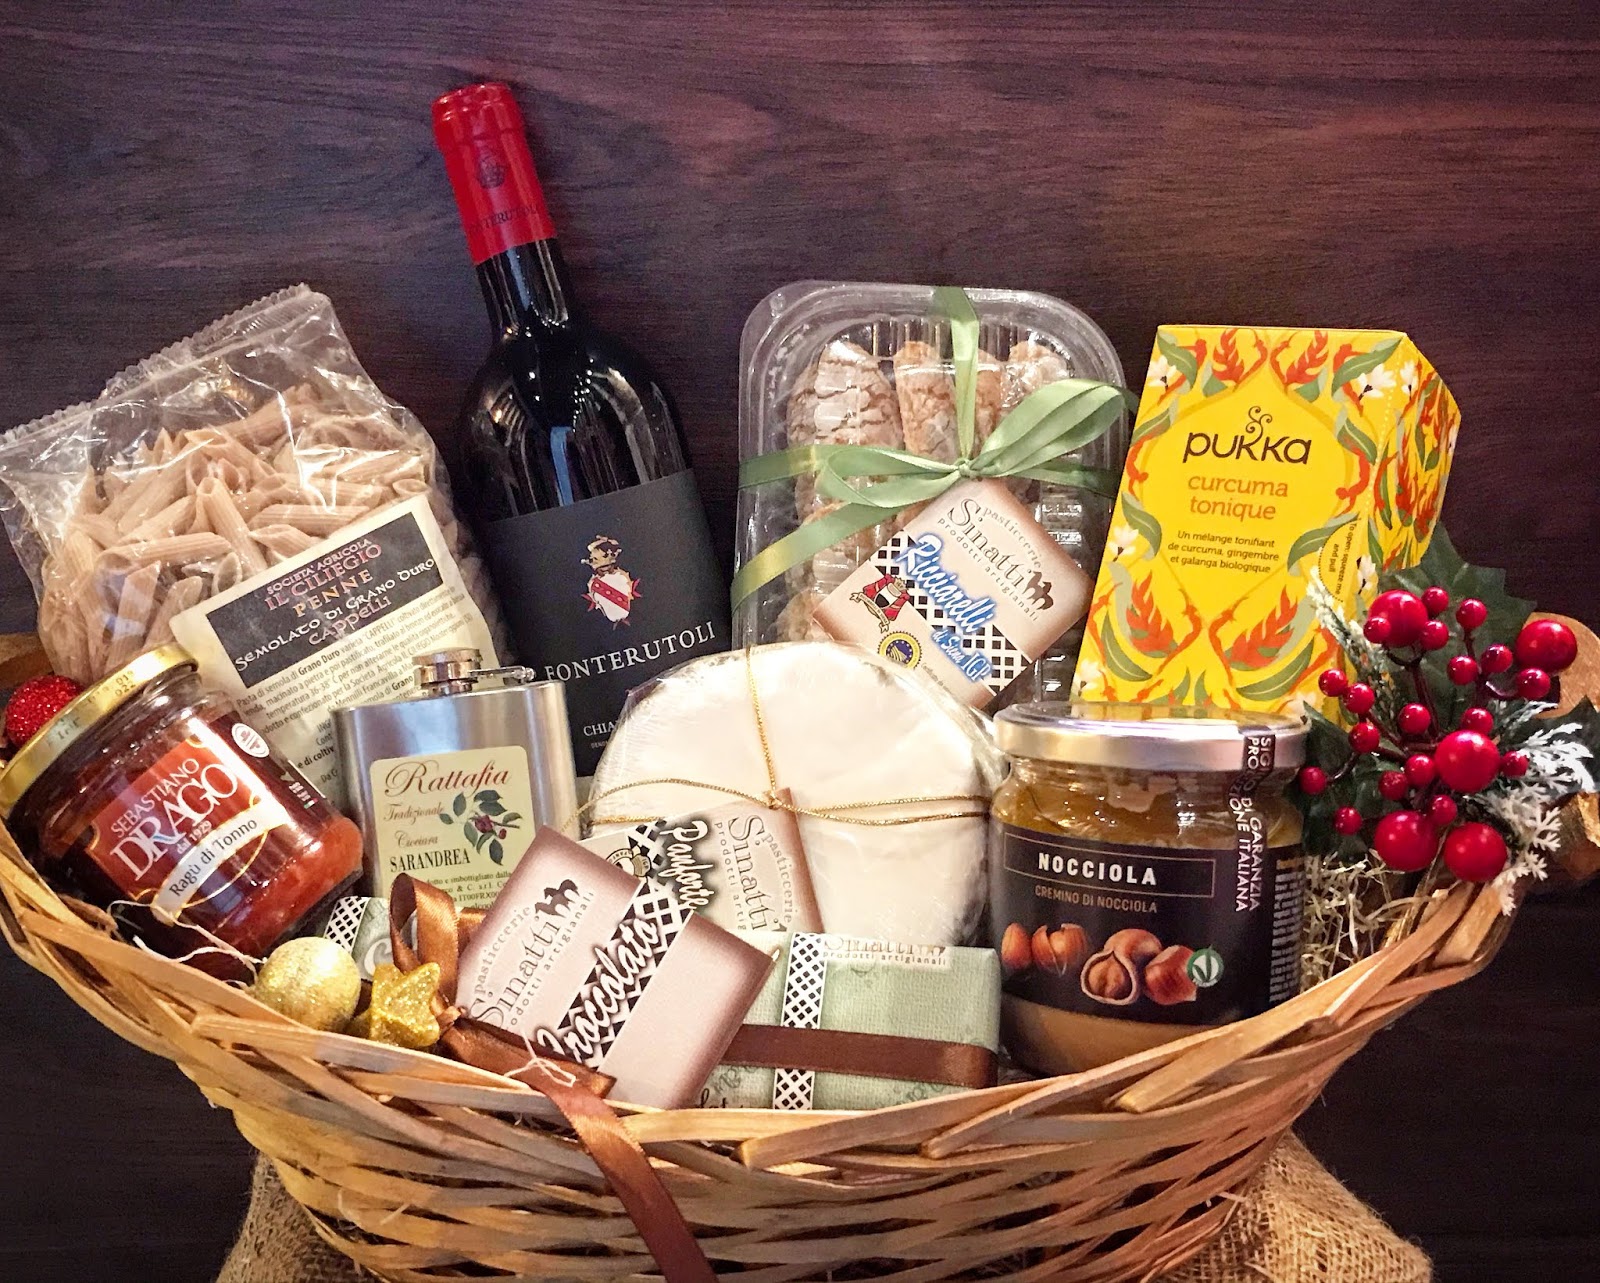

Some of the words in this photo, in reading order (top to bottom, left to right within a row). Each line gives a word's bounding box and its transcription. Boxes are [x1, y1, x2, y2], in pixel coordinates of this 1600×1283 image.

[1183, 424, 1312, 464] pukka
[1188, 476, 1288, 497] curcuma
[1190, 496, 1276, 522] tonique
[317, 538, 372, 571] AGRICOLA
[947, 498, 1032, 588] Sinatti
[983, 506, 1043, 569] pasticcerie
[1168, 542, 1179, 551] de
[1227, 549, 1279, 561] gingembre
[1170, 555, 1179, 563] et
[1181, 557, 1217, 568] galanga
[1220, 560, 1271, 573] biologique
[1177, 530, 1190, 540] Un
[1192, 532, 1233, 545] mélange
[1235, 537, 1275, 548] tonifiant
[264, 594, 289, 611] IL
[291, 544, 382, 596] CILIEGIO
[293, 569, 374, 618] PENNE
[897, 533, 996, 633] Ricciarelli
[937, 517, 982, 563] prodotti
[984, 566, 1040, 622] artigianali
[237, 693, 257, 707] Pasta
[257, 689, 265, 698] di
[265, 676, 290, 693] semola
[291, 671, 298, 680] di
[298, 660, 322, 676] Grano
[321, 649, 340, 664] Duro
[545, 621, 716, 682] FONTERUTOLI
[961, 652, 991, 681] IGP
[266, 686, 298, 706] macinato
[304, 672, 324, 688] pietra
[266, 693, 310, 720] temperatura
[338, 671, 350, 681] per
[350, 664, 364, 674] non
[289, 694, 332, 720] confezionato
[332, 688, 344, 699] per
[377, 655, 402, 673] Agricola
[384, 686, 392, 695] di
[391, 675, 414, 691] Grano
[304, 757, 313, 766] di
[313, 745, 335, 761] coltiv
[583, 720, 618, 737] CHIA
[111, 758, 200, 838] SEBASTIANO
[384, 760, 511, 797] Rattafia
[110, 763, 238, 881] DRAGO
[169, 864, 201, 897] Ragù
[200, 848, 216, 865] di
[213, 819, 258, 851] Tonno
[390, 849, 470, 873] SARANDREA
[657, 819, 715, 910] Panforte
[715, 822, 737, 886] prodotti
[733, 895, 747, 930] artig
[728, 815, 779, 930] Sinatti
[761, 833, 798, 923] pasticcerie
[1037, 851, 1157, 886] NOCCIOLA
[1235, 838, 1250, 912] ITALIANA
[1249, 818, 1263, 911] GARANZIA
[1035, 885, 1080, 905] CREMINO
[1082, 894, 1094, 907] DI
[1096, 896, 1158, 914] NOCCIOLA
[470, 915, 561, 1028] Sinatti
[475, 906, 531, 995] pasticcerie
[510, 978, 542, 1026] odotti
[544, 891, 595, 971] artigianali
[881, 954, 946, 966] artigianali
